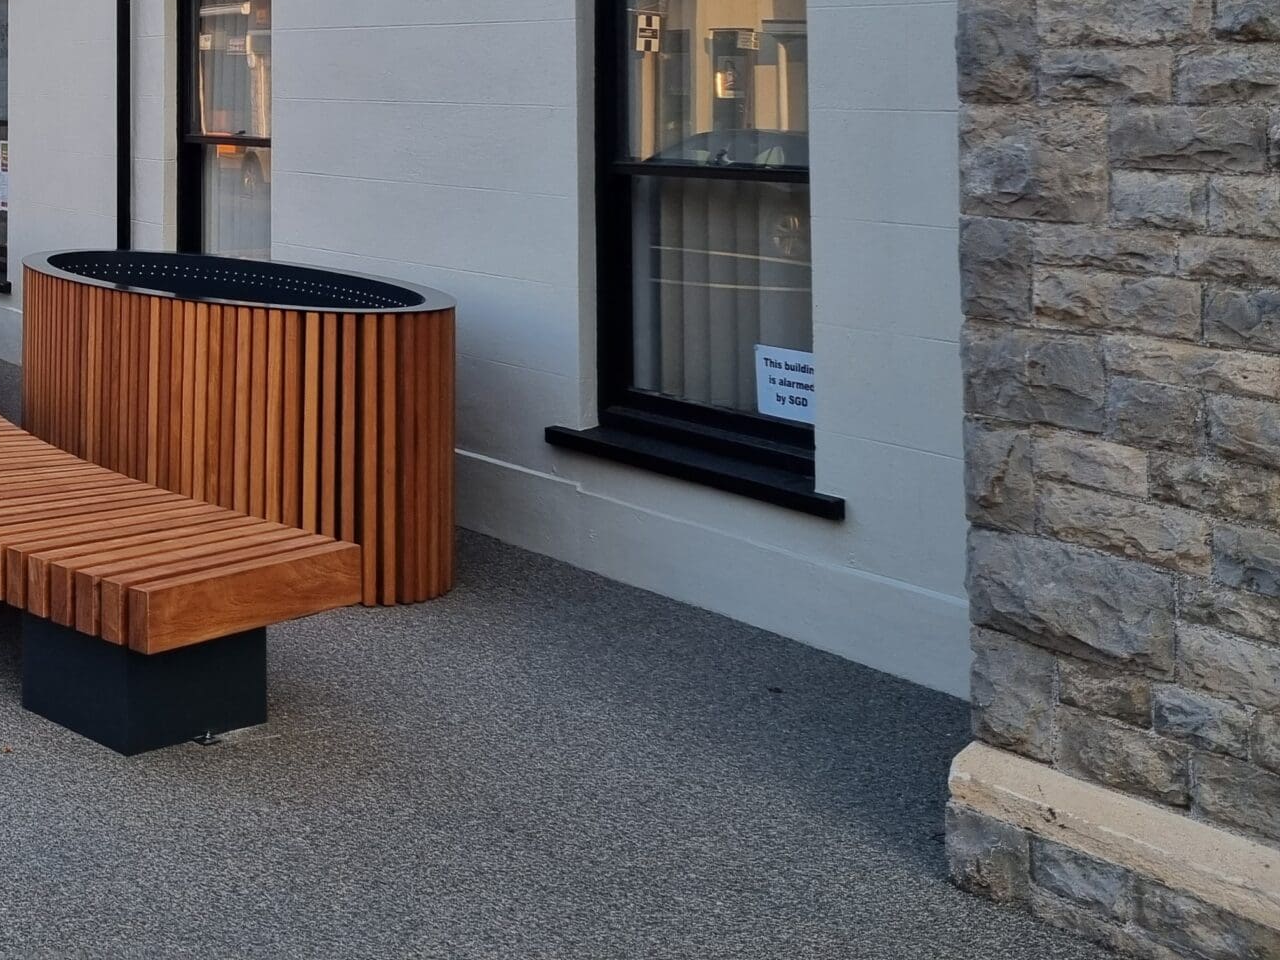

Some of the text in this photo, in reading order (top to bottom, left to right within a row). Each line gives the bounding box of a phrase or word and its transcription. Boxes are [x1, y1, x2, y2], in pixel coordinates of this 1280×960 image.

[763, 357, 814, 375] This buildin
[768, 374, 776, 385] is
[775, 393, 808, 407] by SGD
